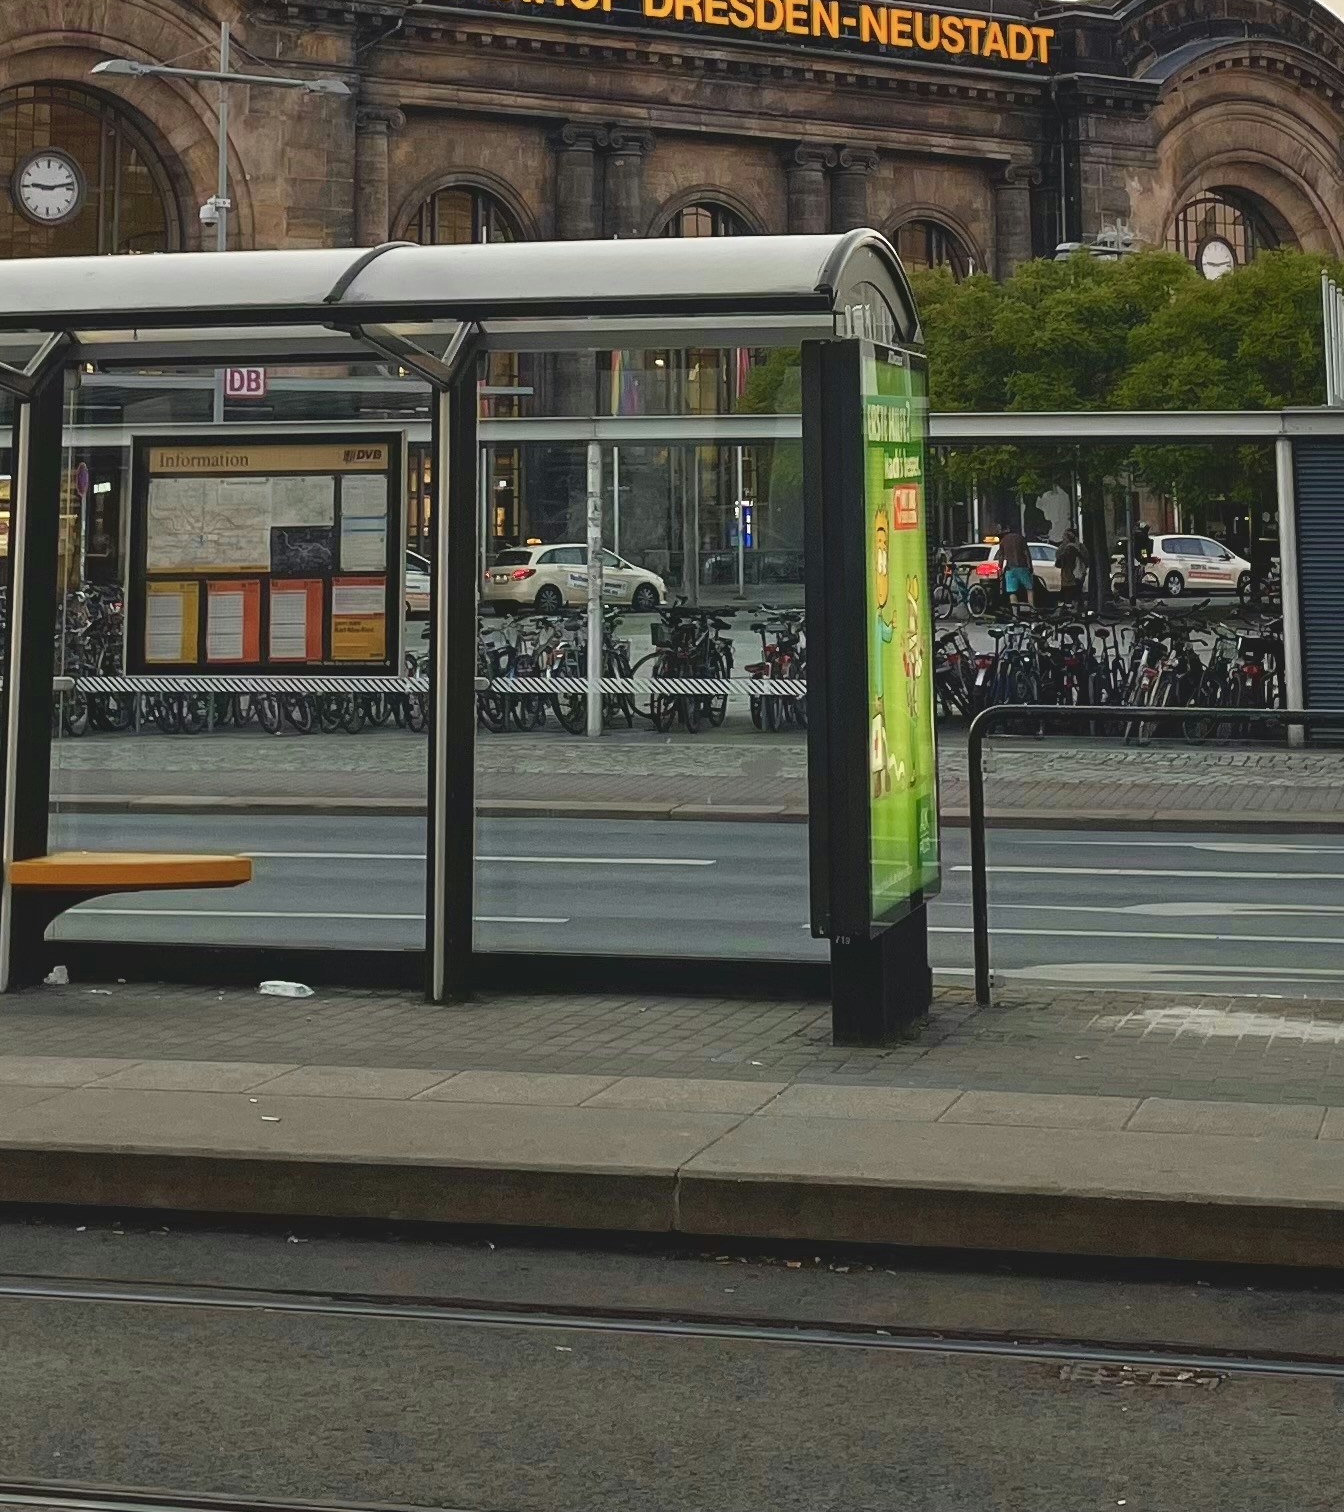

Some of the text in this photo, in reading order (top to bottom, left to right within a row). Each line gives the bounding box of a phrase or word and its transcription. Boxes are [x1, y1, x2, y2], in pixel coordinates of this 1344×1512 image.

[229, 369, 261, 392] DB
[159, 451, 249, 468] Information
[356, 449, 382, 460] DVB
